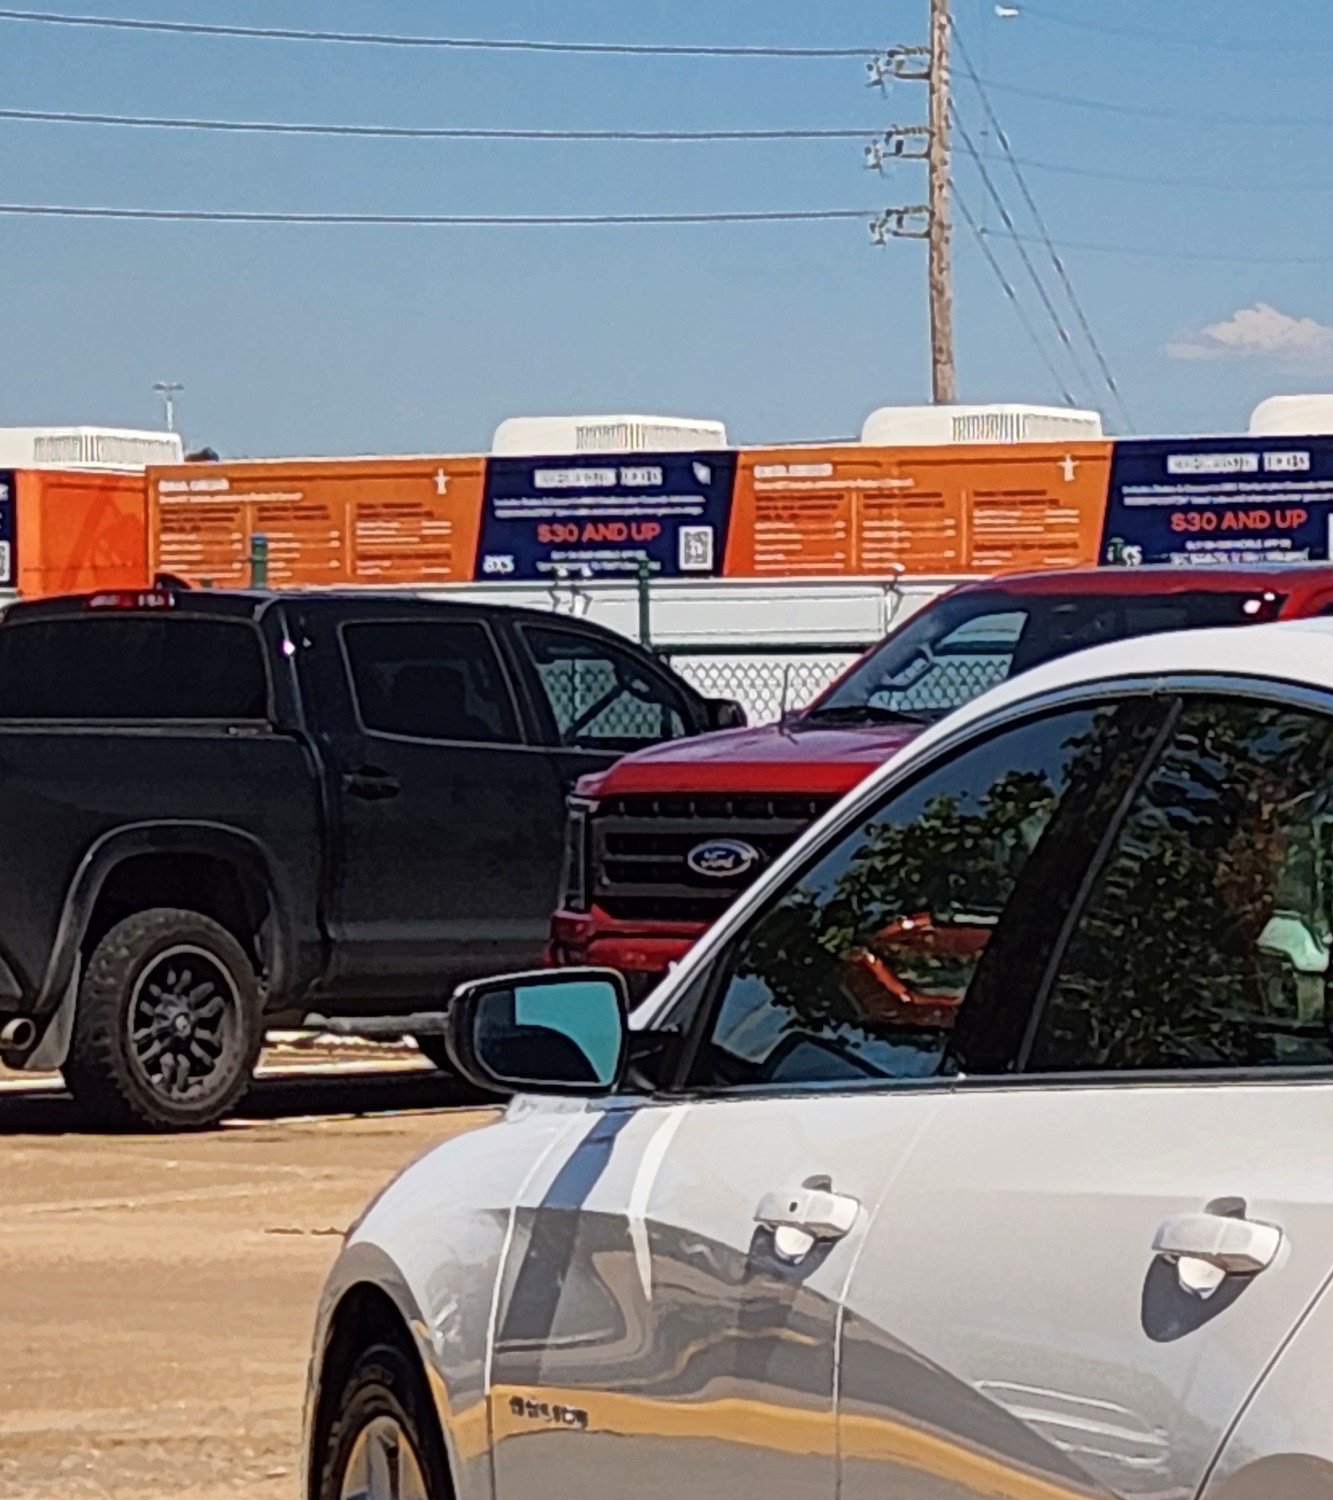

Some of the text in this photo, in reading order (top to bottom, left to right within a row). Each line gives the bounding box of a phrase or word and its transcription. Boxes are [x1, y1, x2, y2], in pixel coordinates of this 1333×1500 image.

[1220, 510, 1271, 531] AND
[1274, 509, 1308, 529] UP
[581, 522, 628, 543] AND
[630, 522, 661, 541] UP
